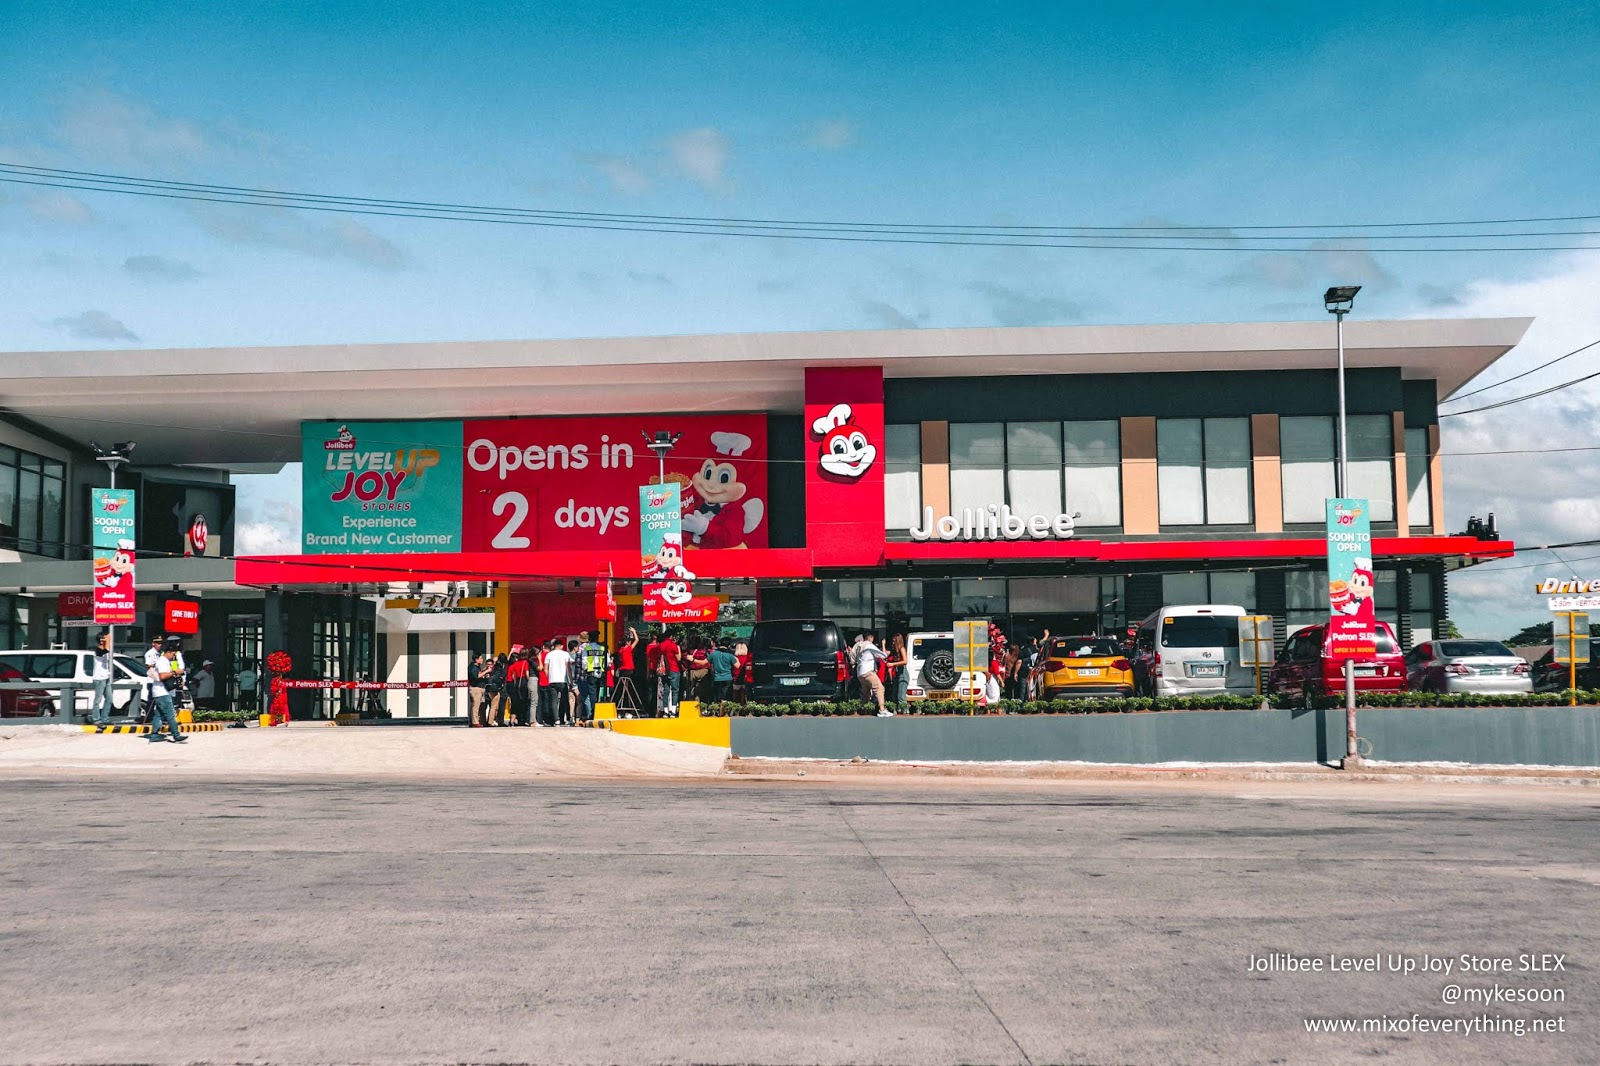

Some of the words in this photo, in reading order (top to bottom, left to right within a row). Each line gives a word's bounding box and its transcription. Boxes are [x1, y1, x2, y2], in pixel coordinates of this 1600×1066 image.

[325, 442, 354, 450] Jollibee
[467, 438, 589, 480] Opens
[601, 434, 633, 469] in
[325, 451, 394, 471] LEVEL
[394, 449, 440, 478] UP
[330, 470, 407, 502] JOY
[103, 503, 120, 511] JOY
[362, 502, 411, 511] STORES
[649, 498, 665, 507] JOY
[94, 517, 120, 526] SOON
[121, 518, 134, 527] TO
[491, 491, 531, 549] 2
[554, 499, 630, 535] days
[641, 512, 665, 523] SOON
[667, 511, 679, 520] TO
[909, 504, 1076, 540] Jollibee
[1337, 515, 1355, 525] JOY
[342, 515, 417, 531] Experience
[648, 521, 671, 530] OPEN
[102, 526, 126, 535] OPEN
[306, 533, 347, 545] Brand
[351, 532, 383, 545] New
[386, 532, 453, 545] Customer
[1328, 532, 1355, 542] SOON
[1356, 533, 1370, 542] TO
[1337, 542, 1362, 552] OPEN
[1540, 575, 1600, 594] Drive
[662, 609, 702, 618] Drive-Thru
[1341, 621, 1367, 629] Jollibee
[1332, 633, 1358, 641] Petron
[354, 681, 381, 689] Jollibee
[442, 680, 468, 688] Jollibee
